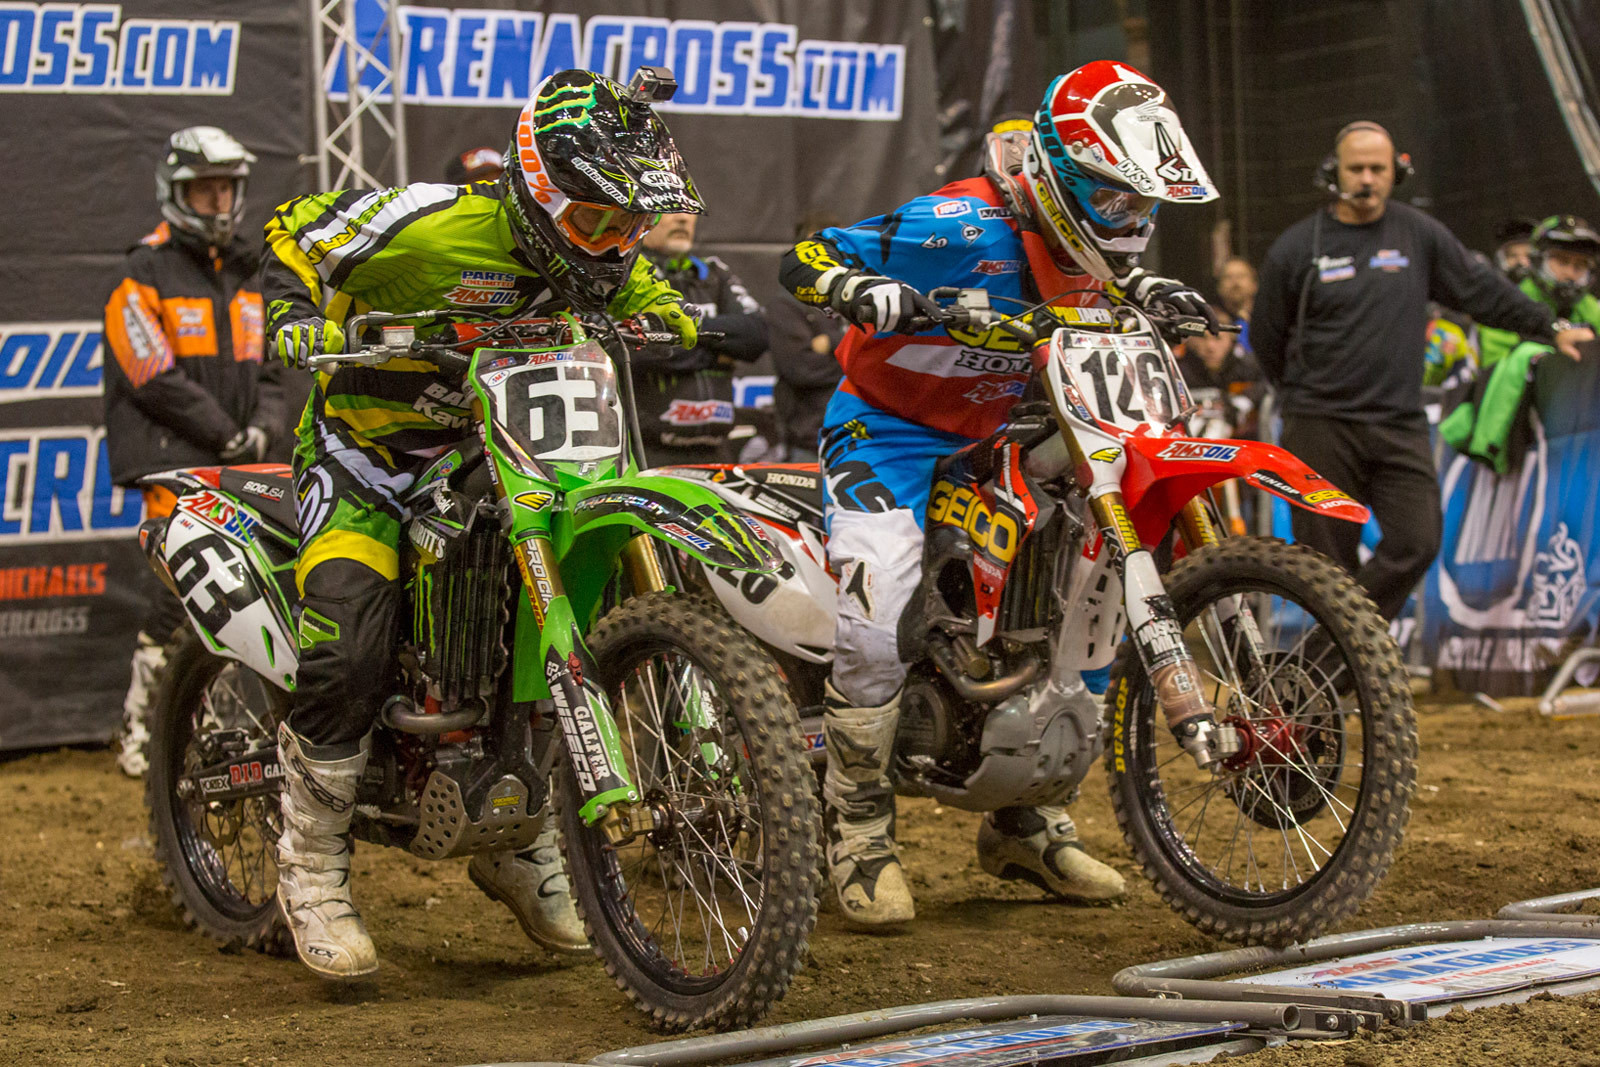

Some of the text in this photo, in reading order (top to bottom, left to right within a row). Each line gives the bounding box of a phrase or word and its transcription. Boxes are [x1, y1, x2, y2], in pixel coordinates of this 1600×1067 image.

[1166, 185, 1208, 197] AMSOIL
[461, 270, 515, 282] PARTS
[972, 260, 1020, 276] AMSOIL
[461, 279, 514, 288] UNLIMITED
[444, 286, 519, 306] AMSOIL
[526, 352, 575, 366] AMSOIL
[1080, 350, 1174, 425] 126
[506, 366, 620, 454] 63
[1158, 441, 1240, 462] AMSOIL
[765, 472, 817, 489] HONDA
[1250, 472, 1301, 496] DUNLOP
[927, 480, 1018, 563] GEICO
[525, 538, 546, 580] PRO
[166, 533, 263, 637] 63
[1113, 676, 1129, 775] DUNLOP
[550, 681, 598, 794] WISECO
[572, 705, 611, 781] GALFER
[306, 945, 338, 961] TCX
